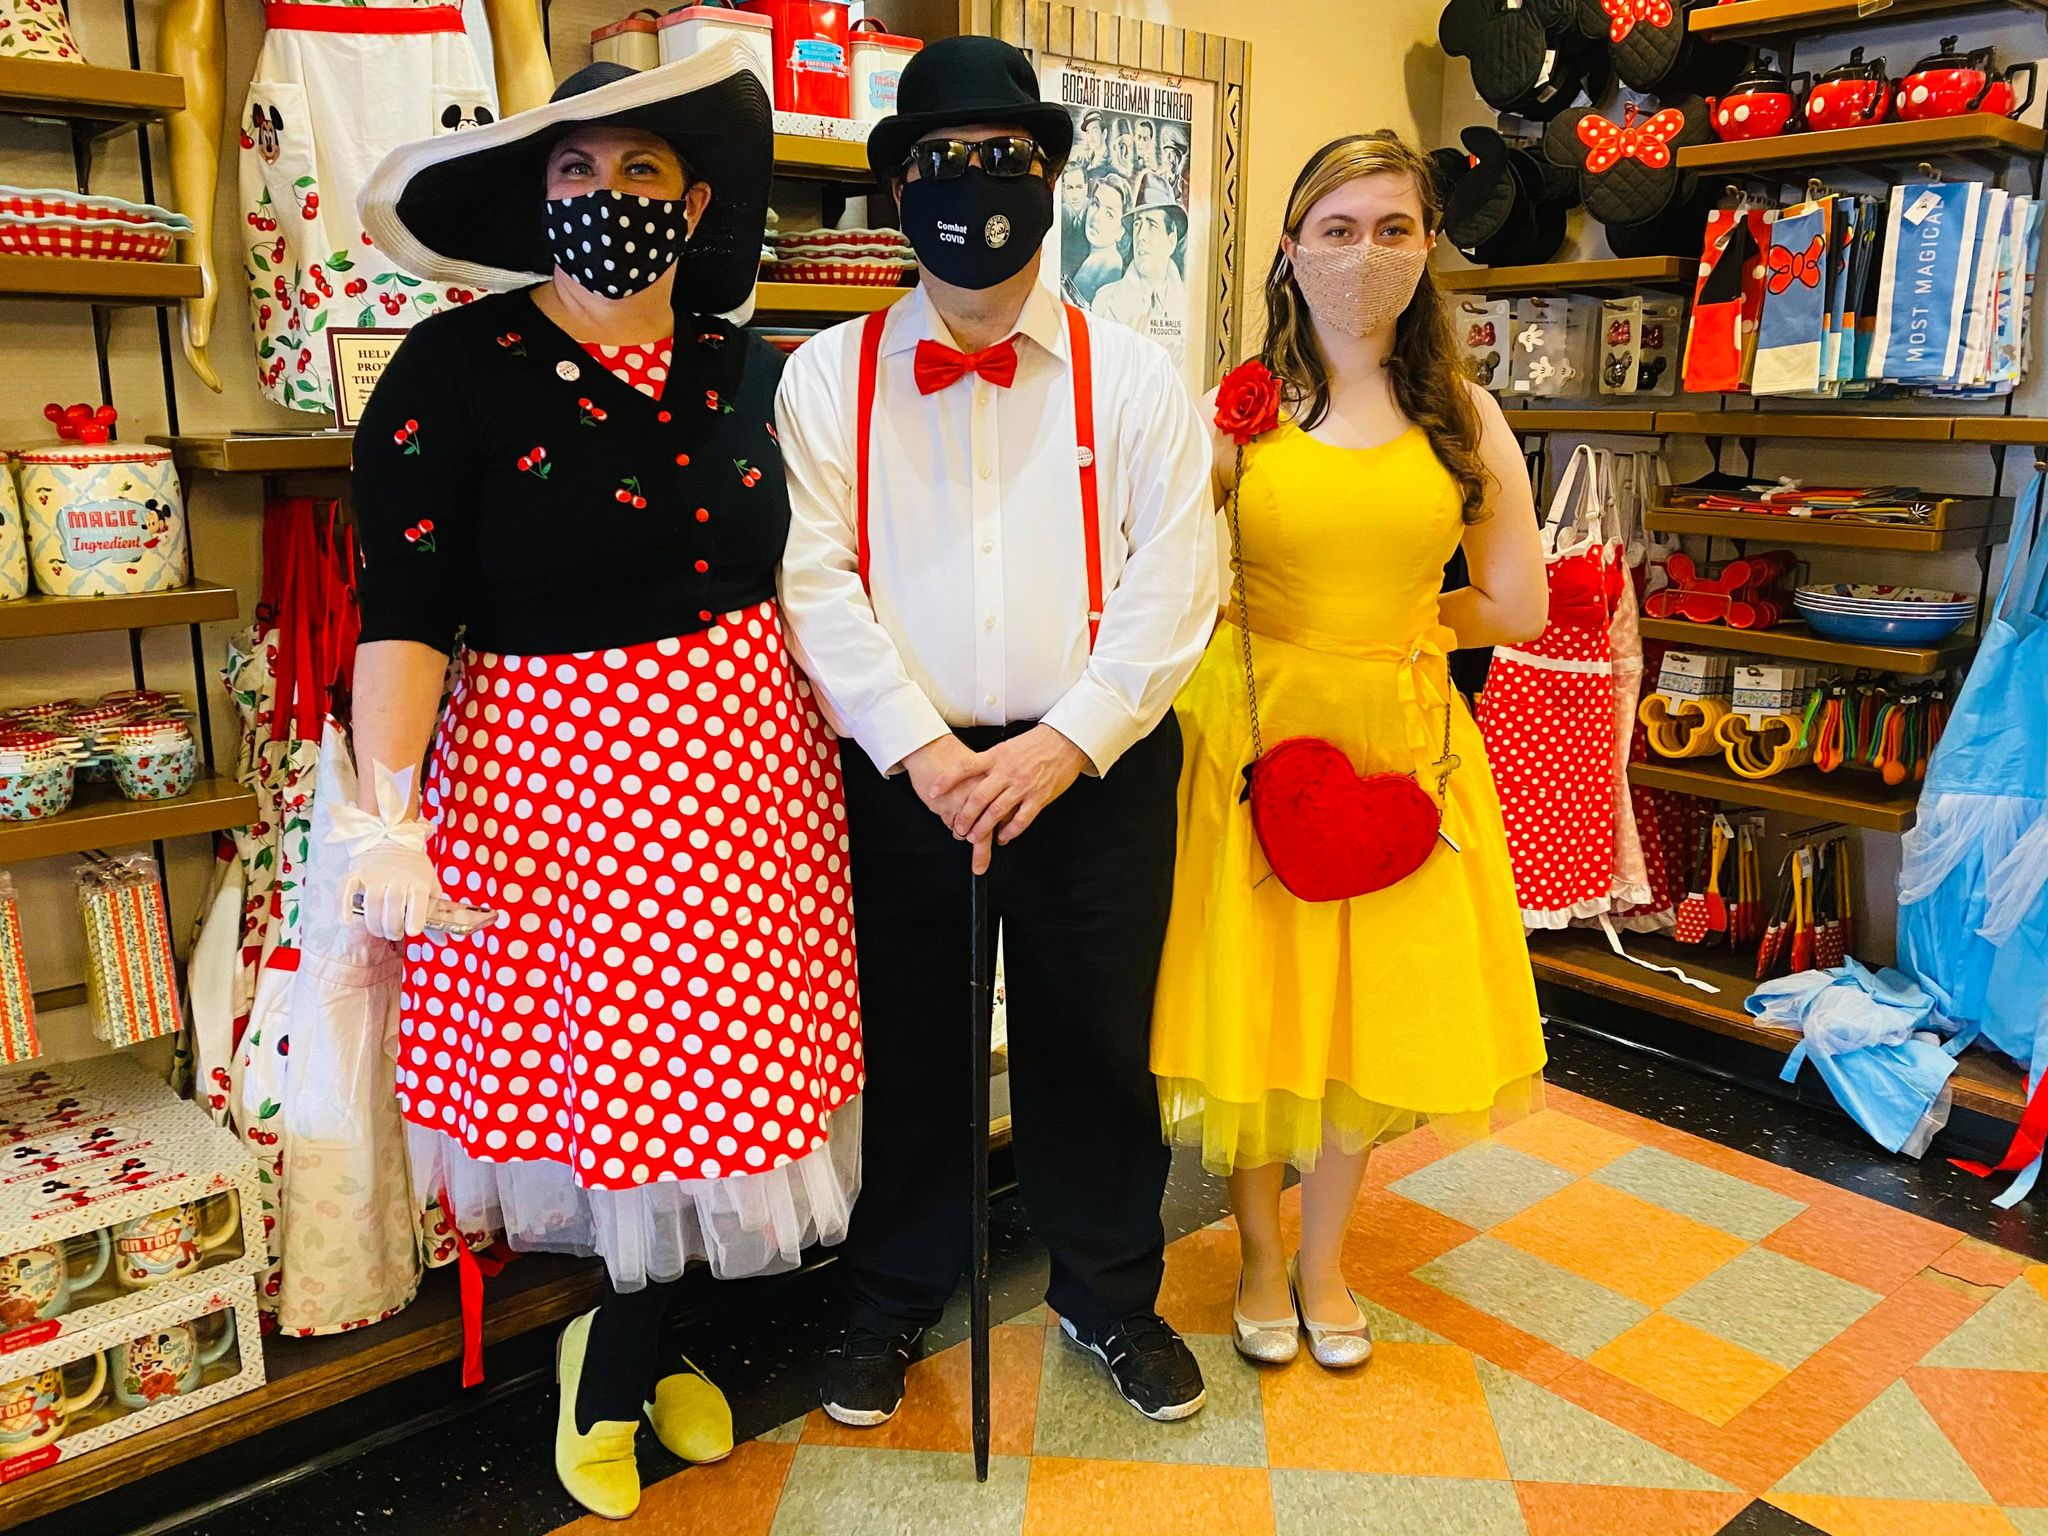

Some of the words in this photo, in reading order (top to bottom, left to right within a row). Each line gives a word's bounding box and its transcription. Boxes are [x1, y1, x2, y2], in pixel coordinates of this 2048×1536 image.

[1062, 73, 1101, 108] BOGART
[1103, 80, 1150, 115] BERGMAN
[1154, 88, 1193, 121] HENREID
[937, 220, 968, 234] Combat
[940, 232, 965, 245] COVID
[1914, 200, 1945, 294] MAGICAL
[1906, 307, 1930, 362] MOST
[358, 350, 390, 358] HELP
[352, 376, 378, 384] THE
[67, 509, 138, 529] MAGIC
[72, 536, 141, 553] Ingredient
[120, 1239, 141, 1252] ON
[143, 1231, 178, 1251] TOP
